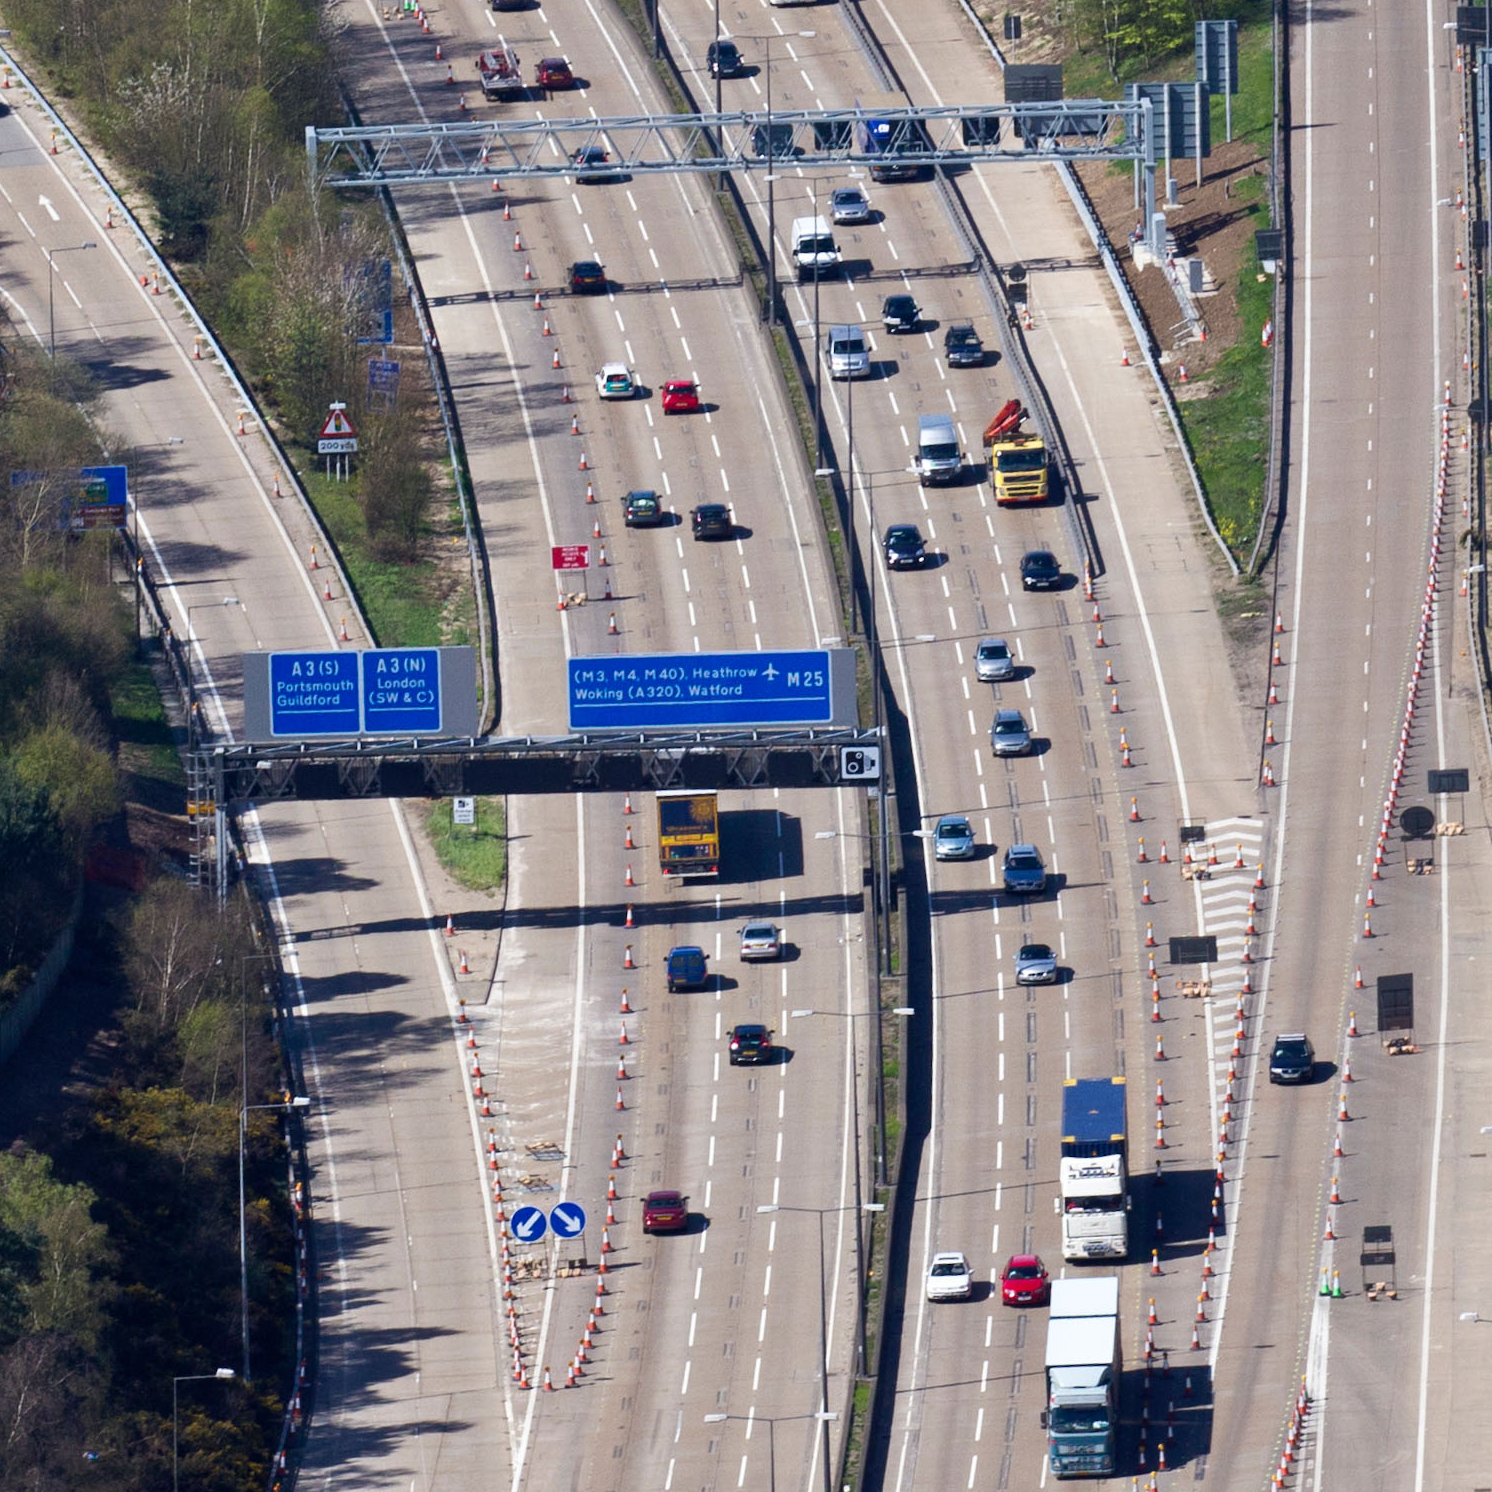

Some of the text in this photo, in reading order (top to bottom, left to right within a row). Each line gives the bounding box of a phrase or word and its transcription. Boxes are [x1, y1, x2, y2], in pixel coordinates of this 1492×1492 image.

[321, 442, 339, 450] 200
[693, 667, 757, 678] Heathrow
[277, 680, 354, 692] Portsmouth
[378, 676, 425, 689] London
[369, 690, 435, 705] (SW & C)
[576, 688, 623, 700] Woking
[689, 684, 743, 696] Watford
[277, 694, 340, 706] Guildford
